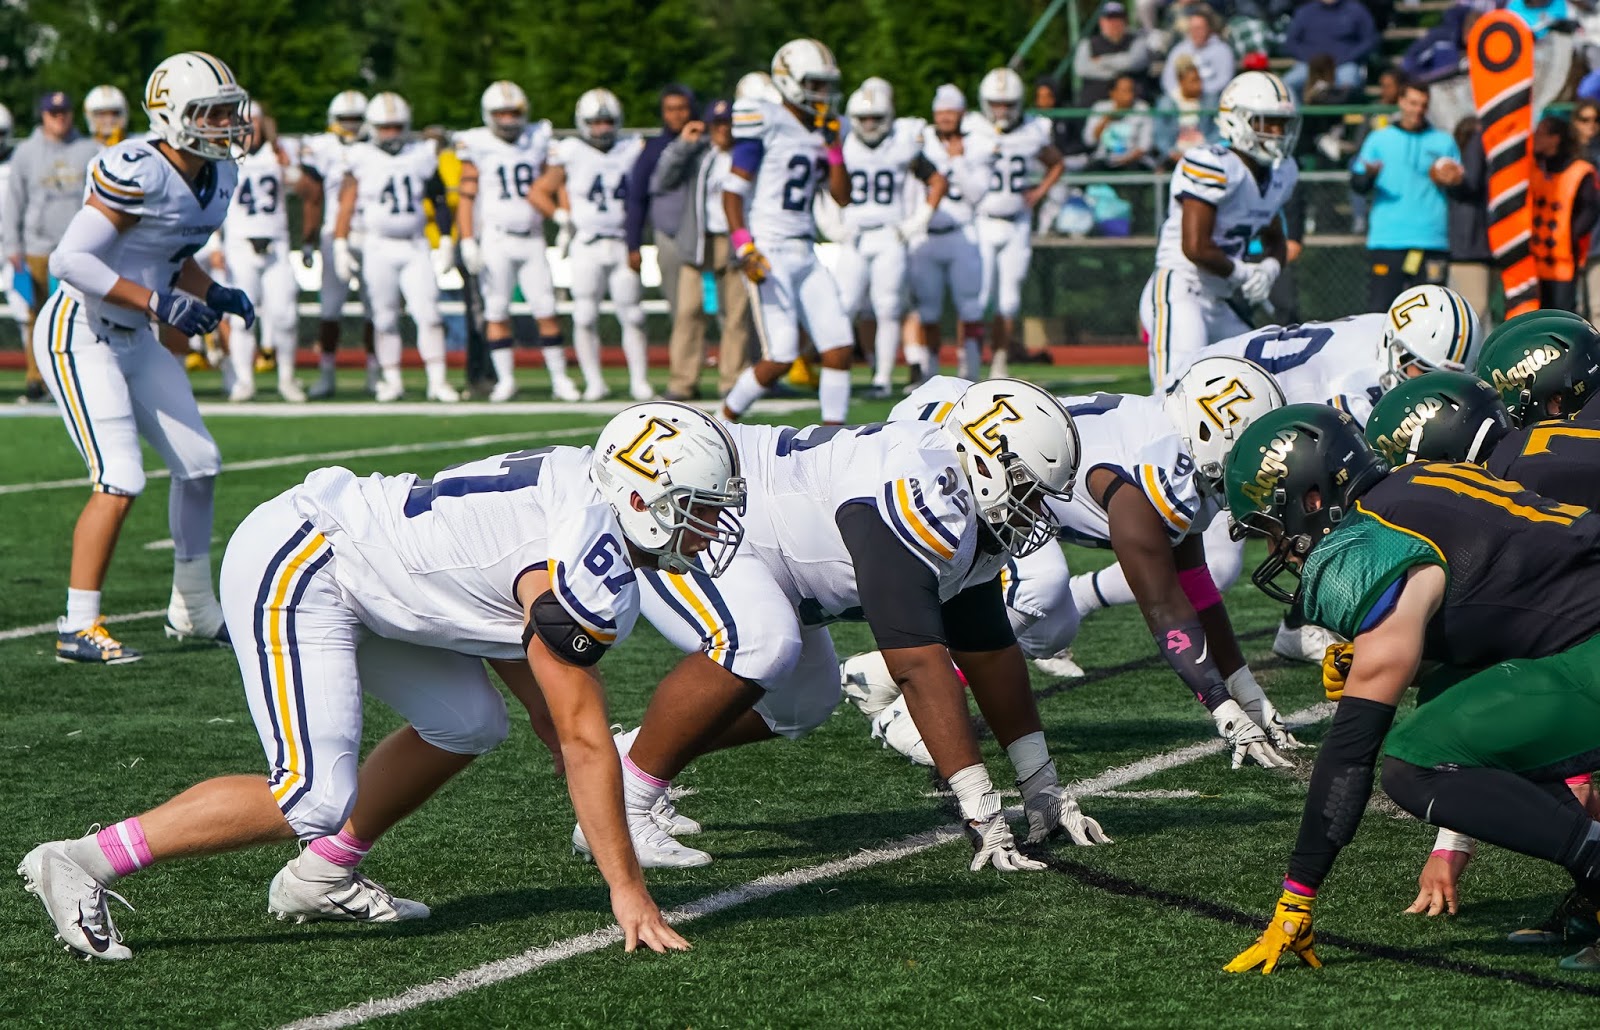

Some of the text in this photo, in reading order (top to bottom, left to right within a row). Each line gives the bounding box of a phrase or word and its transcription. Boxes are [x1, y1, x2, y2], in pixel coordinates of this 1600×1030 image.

[238, 176, 278, 215] 43
[380, 176, 416, 213] 41
[1391, 293, 1430, 330] L
[1492, 344, 1561, 400] Aggies
[961, 397, 1024, 459] L
[1196, 377, 1255, 431] L
[613, 416, 681, 483] L
[1241, 429, 1299, 512] Aggies
[583, 533, 637, 596] 67
